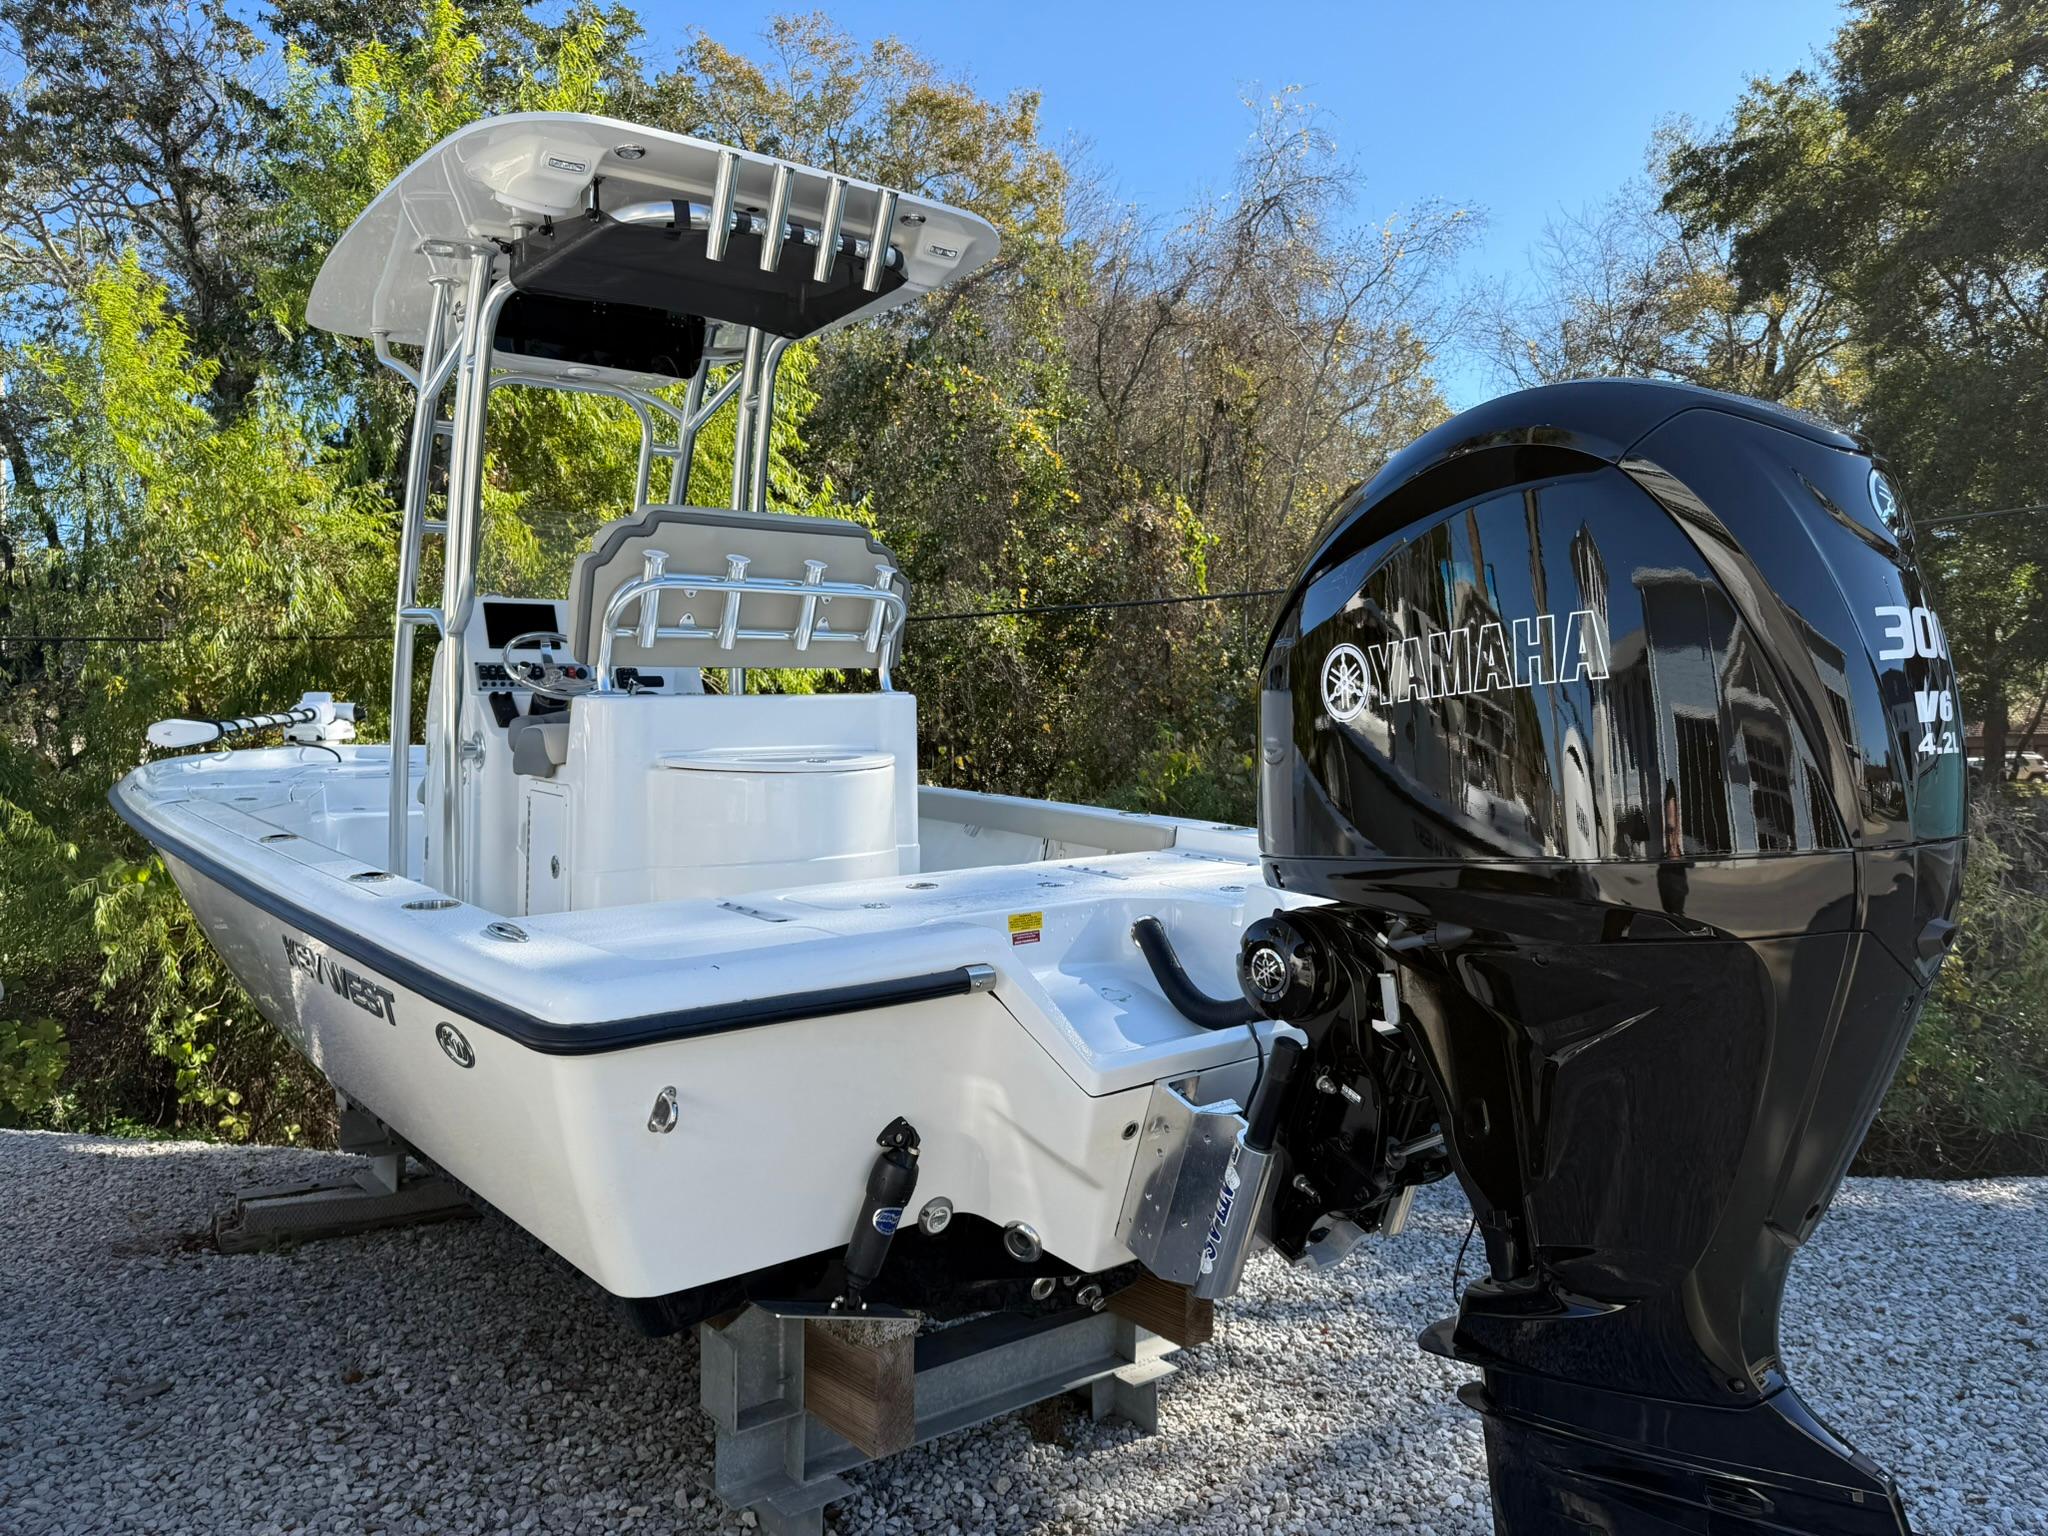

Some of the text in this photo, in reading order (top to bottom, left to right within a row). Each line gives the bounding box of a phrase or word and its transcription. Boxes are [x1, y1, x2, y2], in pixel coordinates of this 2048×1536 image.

[1368, 610, 1610, 706] YAMAHA
[1914, 690, 1953, 723] V6
[1918, 732, 1960, 755] 4.2L
[322, 956, 397, 1027] WEST
